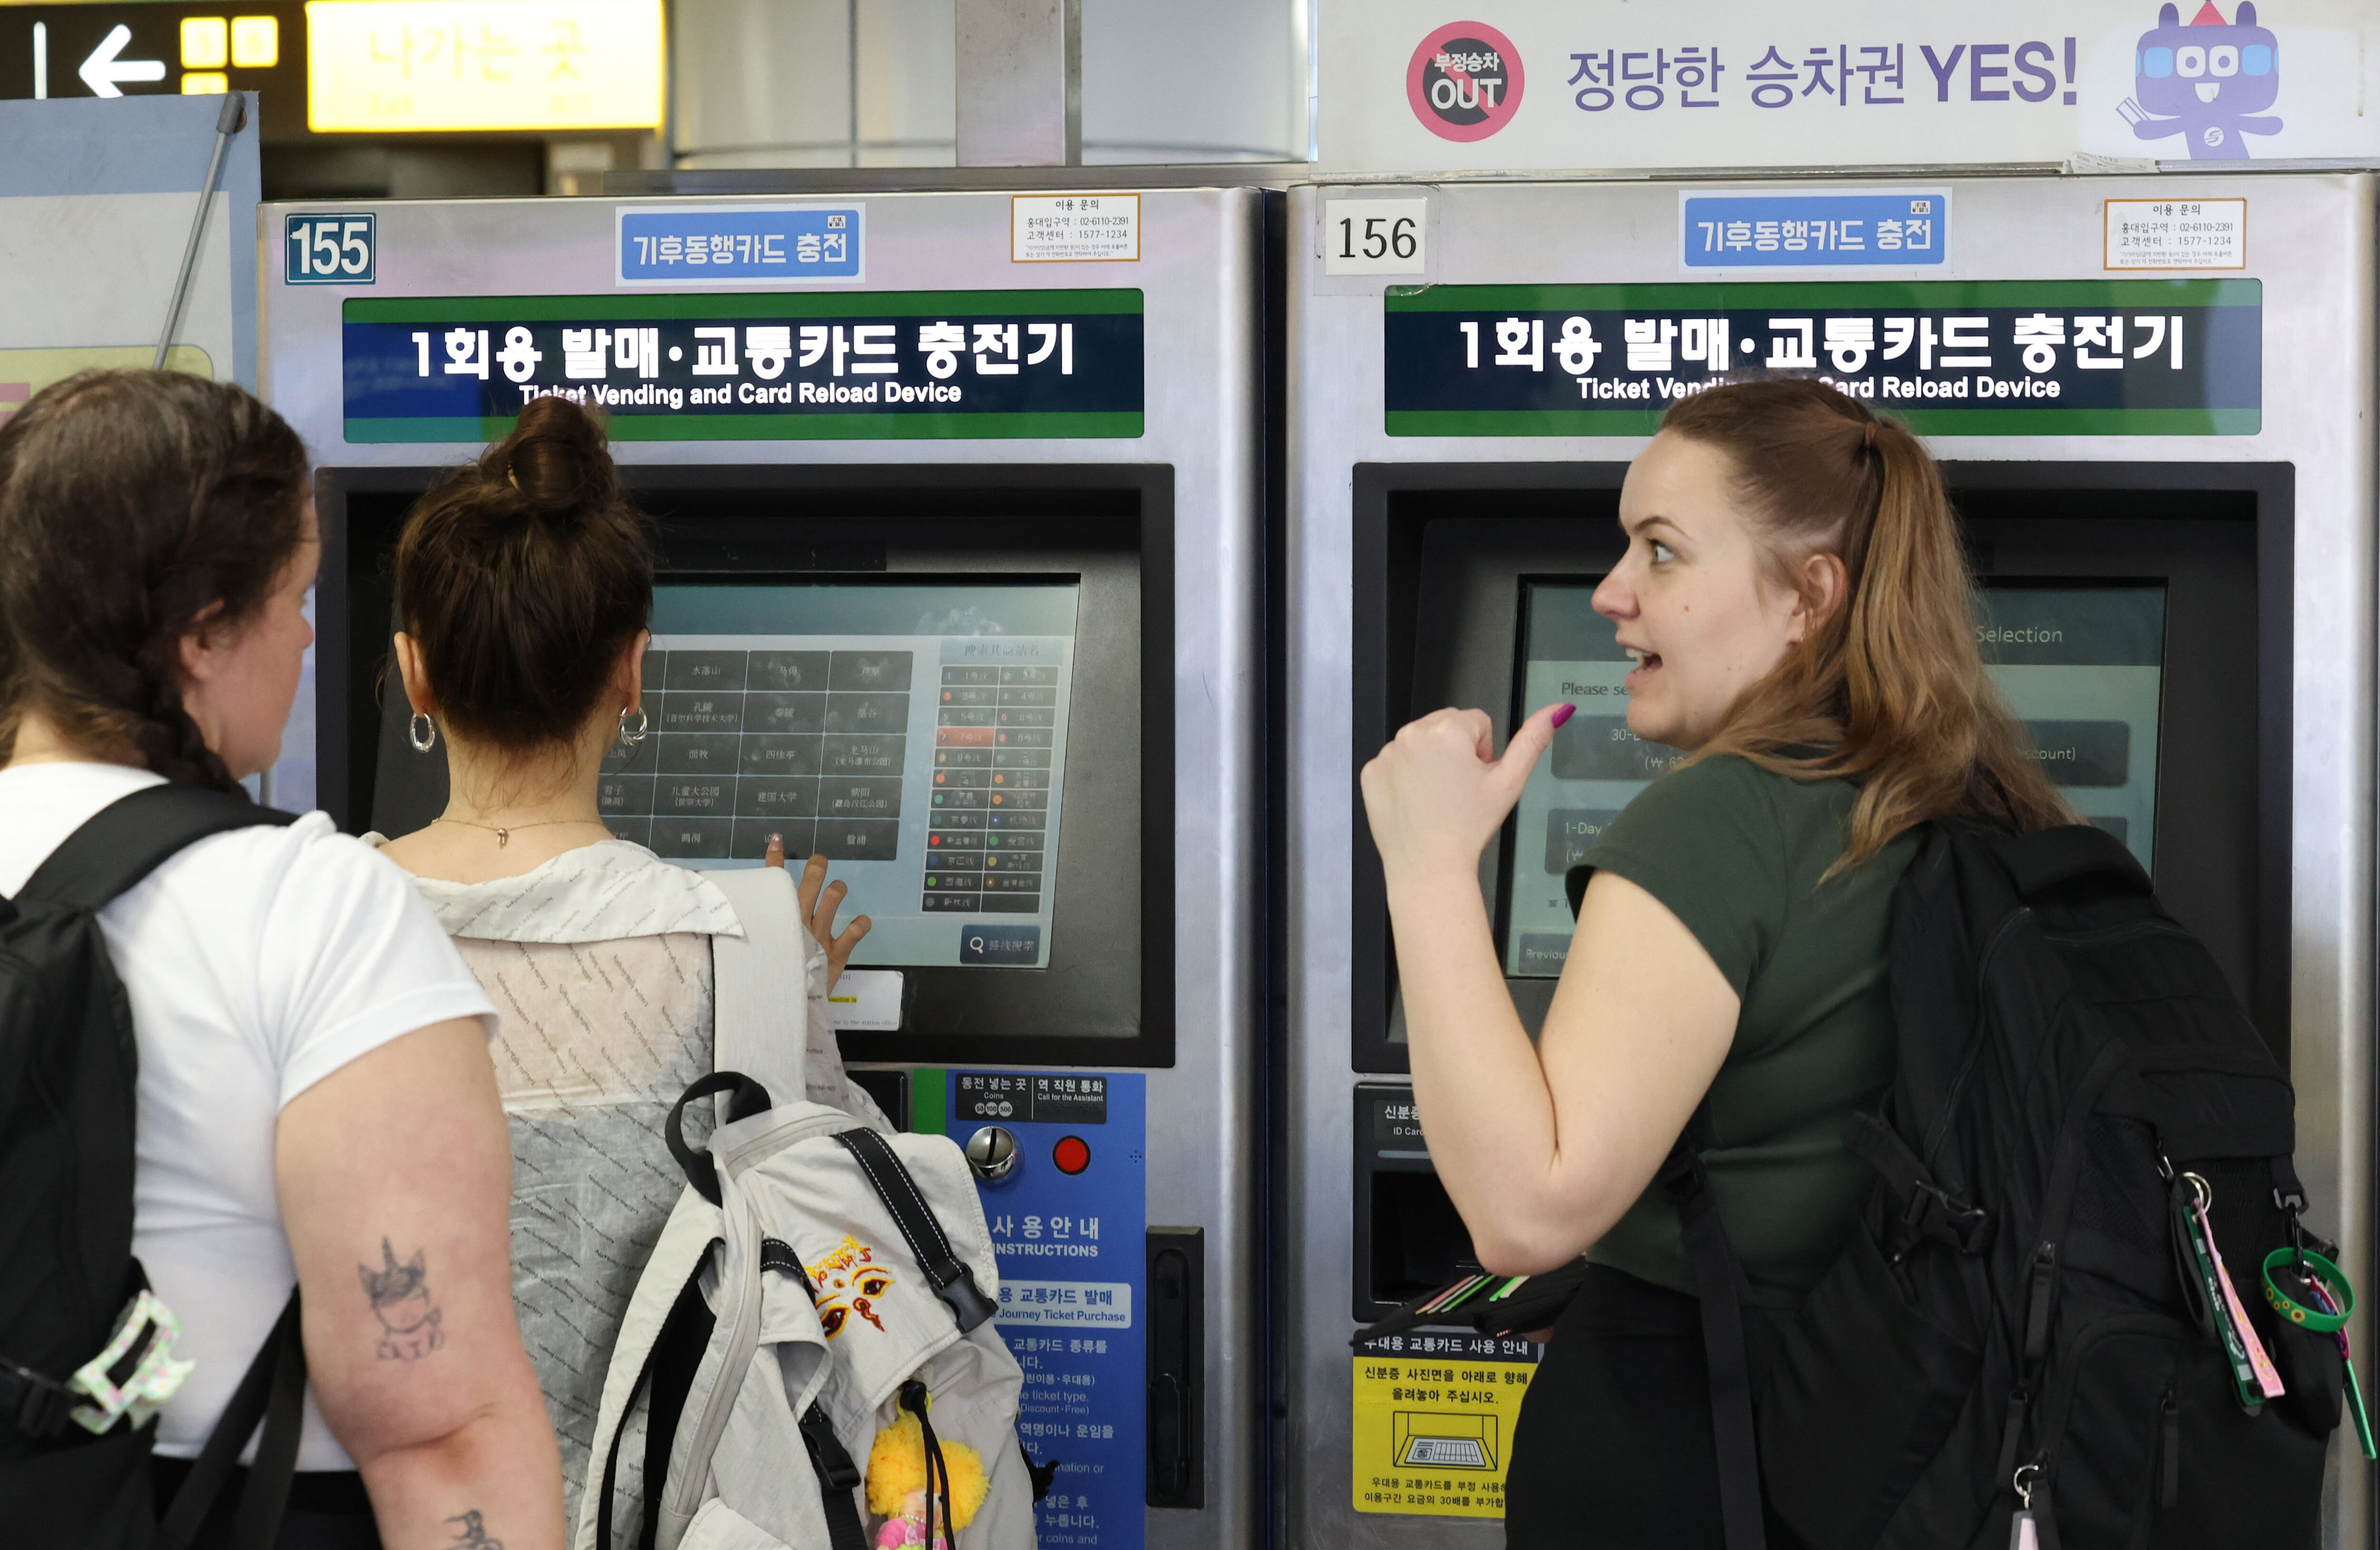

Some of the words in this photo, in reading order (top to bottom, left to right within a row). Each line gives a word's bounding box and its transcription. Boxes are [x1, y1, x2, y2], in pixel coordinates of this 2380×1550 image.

[1434, 52, 1499, 72] 부정승차
[1567, 46, 1725, 111] 정당한
[1746, 43, 1904, 108] 승차권
[1919, 37, 2076, 105] YES!
[1431, 78, 1502, 110] OUT
[1056, 199, 1074, 210] 이용
[1080, 199, 1099, 210] 문의
[2153, 204, 2173, 215] 이용
[2180, 204, 2201, 215] 문의
[1027, 217, 1070, 228] 홍대입구역
[1080, 217, 1129, 225] 02-6110-2391
[2121, 223, 2168, 233] 홍대입구역
[2180, 223, 2233, 231] 02-6110-2391
[1027, 230, 1063, 240] 고객센터
[1079, 230, 1127, 239] 1577-1234
[1339, 218, 1417, 258] 156
[1698, 219, 1864, 252] 기후동행카드
[1876, 218, 1931, 251] 충전
[2121, 237, 2161, 247] 고객센터
[2179, 237, 2231, 245] 1577-1234
[291, 223, 369, 275] 155
[633, 234, 786, 266] 기후동행카드
[797, 233, 847, 263] 충전
[1460, 316, 1601, 375] 1회용
[2013, 314, 2183, 373] 충전기
[411, 327, 541, 384] 1회용
[917, 322, 1073, 379] 충전기
[1577, 377, 1650, 399] Ticket
[1882, 376, 1968, 398] Reload
[1977, 376, 2060, 398] Device
[592, 384, 683, 409] Vending
[690, 384, 731, 405] and
[739, 383, 792, 404] Card
[799, 382, 878, 404] Reload
[886, 382, 961, 404] Device
[1976, 626, 2062, 642] Selection
[1562, 682, 1608, 696] Please
[1565, 822, 1602, 837] 1-Day
[1525, 949, 1567, 960] Previou
[962, 1077, 983, 1090] 동전
[989, 1078, 1011, 1090] 넣는
[1015, 1078, 1026, 1090] 곳
[1038, 1079, 1048, 1092] 역
[1054, 1079, 1075, 1092] 직원
[1080, 1080, 1103, 1093] 통화
[1393, 1127, 1402, 1135] ID
[995, 1243, 1099, 1257] INSTRUCTIONS
[1020, 1288, 1077, 1305] 교통카드
[1085, 1289, 1112, 1306] 발매
[999, 1309, 1039, 1322] Journey
[1044, 1309, 1074, 1321] Ticket
[1077, 1310, 1125, 1322] Purchase
[1014, 1338, 1063, 1352] 교통카드
[1410, 1337, 1463, 1352] 교통카드
[1470, 1339, 1495, 1354] 사용
[1502, 1340, 1528, 1355] 안내
[1365, 1367, 1400, 1380] 신분증
[1407, 1368, 1454, 1382] 사진면을
[1461, 1371, 1497, 1383] 아래로
[1504, 1372, 1527, 1385] 향해
[1033, 1391, 1060, 1401] ticket
[1447, 1390, 1499, 1404] 주십시오.
[1372, 1477, 1399, 1488] 우대용
[1405, 1479, 1451, 1491] 교통카드를
[1458, 1481, 1476, 1491] 부정
[1365, 1492, 1402, 1504] 이용구간
[1407, 1495, 1435, 1505] 요금의
[1047, 1533, 1074, 1544] coins
[1078, 1535, 1097, 1544] and
